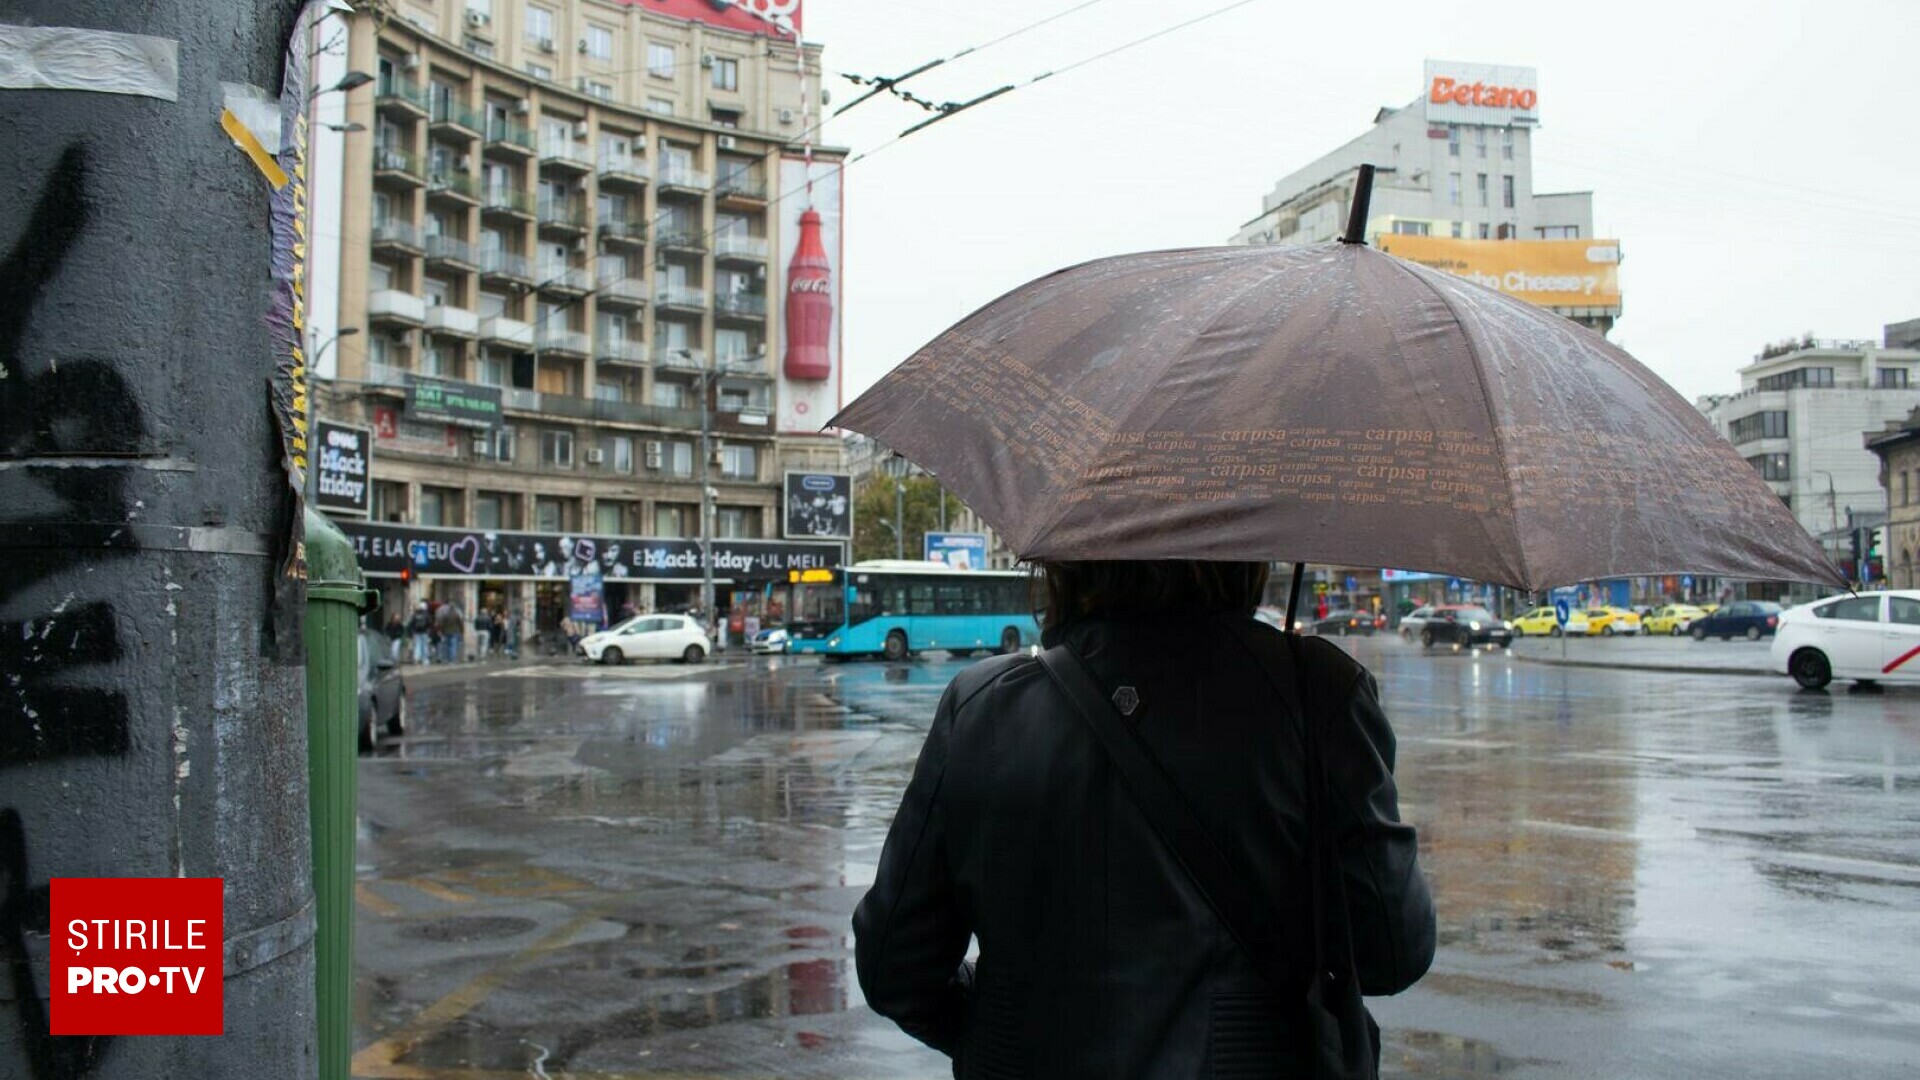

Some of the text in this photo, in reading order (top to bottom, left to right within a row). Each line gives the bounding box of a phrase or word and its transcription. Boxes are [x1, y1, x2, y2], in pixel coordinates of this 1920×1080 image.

[1429, 76, 1537, 110] Betano
[1147, 439, 1196, 451] carpisa
[1290, 438, 1341, 450] carpisa
[1221, 429, 1287, 445] carpisa
[1366, 429, 1434, 446] carpisa
[1210, 464, 1277, 480] carpisa
[1357, 465, 1428, 483] carpisa
[1136, 475, 1186, 487] carpisa
[1280, 474, 1333, 487] carpisa
[1431, 480, 1485, 496] carpisa
[384, 539, 404, 557] LA
